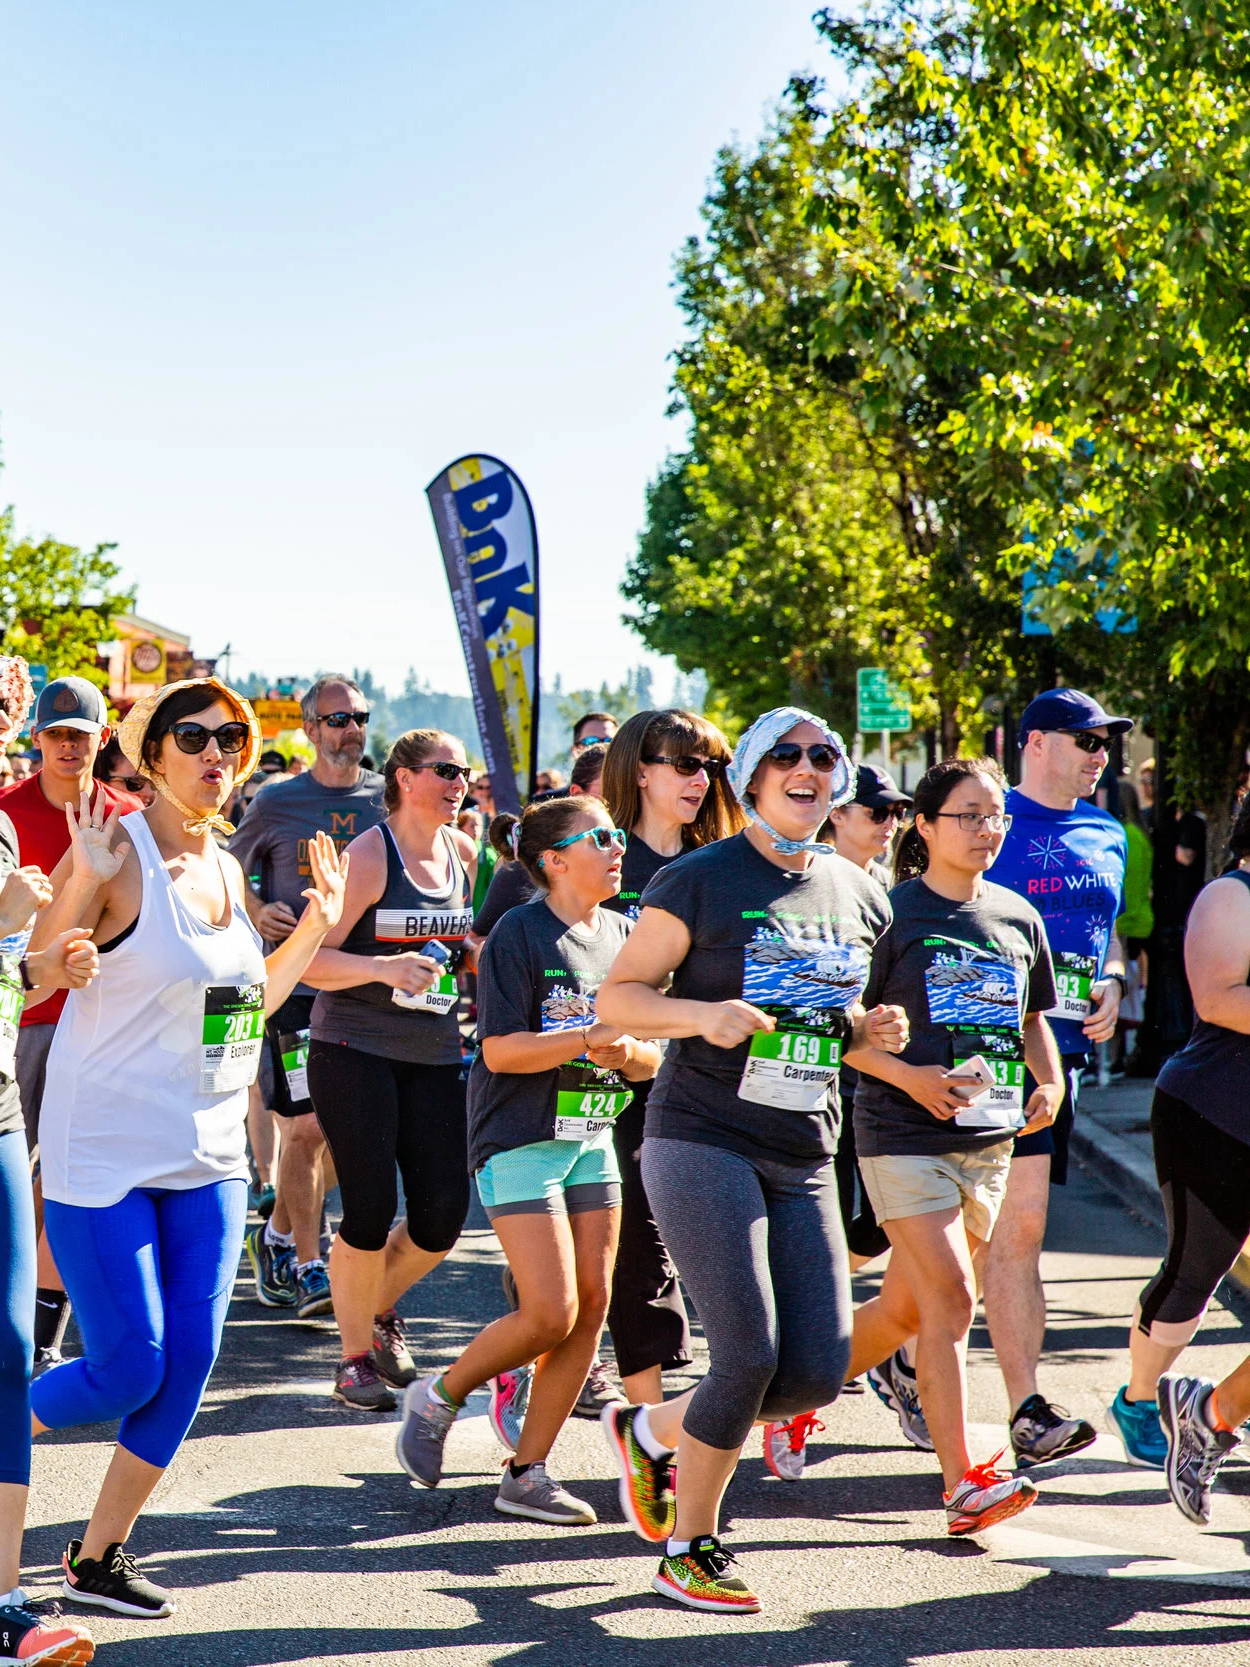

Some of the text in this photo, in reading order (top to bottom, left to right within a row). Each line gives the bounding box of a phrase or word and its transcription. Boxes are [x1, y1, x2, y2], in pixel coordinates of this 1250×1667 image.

[442, 492, 459, 540] Building
[455, 556, 467, 578] Our
[453, 470, 534, 640] BnK
[330, 812, 357, 835] M
[1028, 872, 1118, 894] RED WHITE
[1051, 892, 1106, 911] BLUES
[544, 969, 567, 977] RUN,
[426, 994, 452, 1007] Doctor
[1064, 1000, 1089, 1013] Doctor
[224, 1013, 253, 1043] 203
[231, 1043, 256, 1059] Explorer
[777, 1034, 821, 1064] 169
[784, 1065, 834, 1083] Carpenter
[989, 1087, 1014, 1100] Doctor
[579, 1093, 617, 1117] 424
